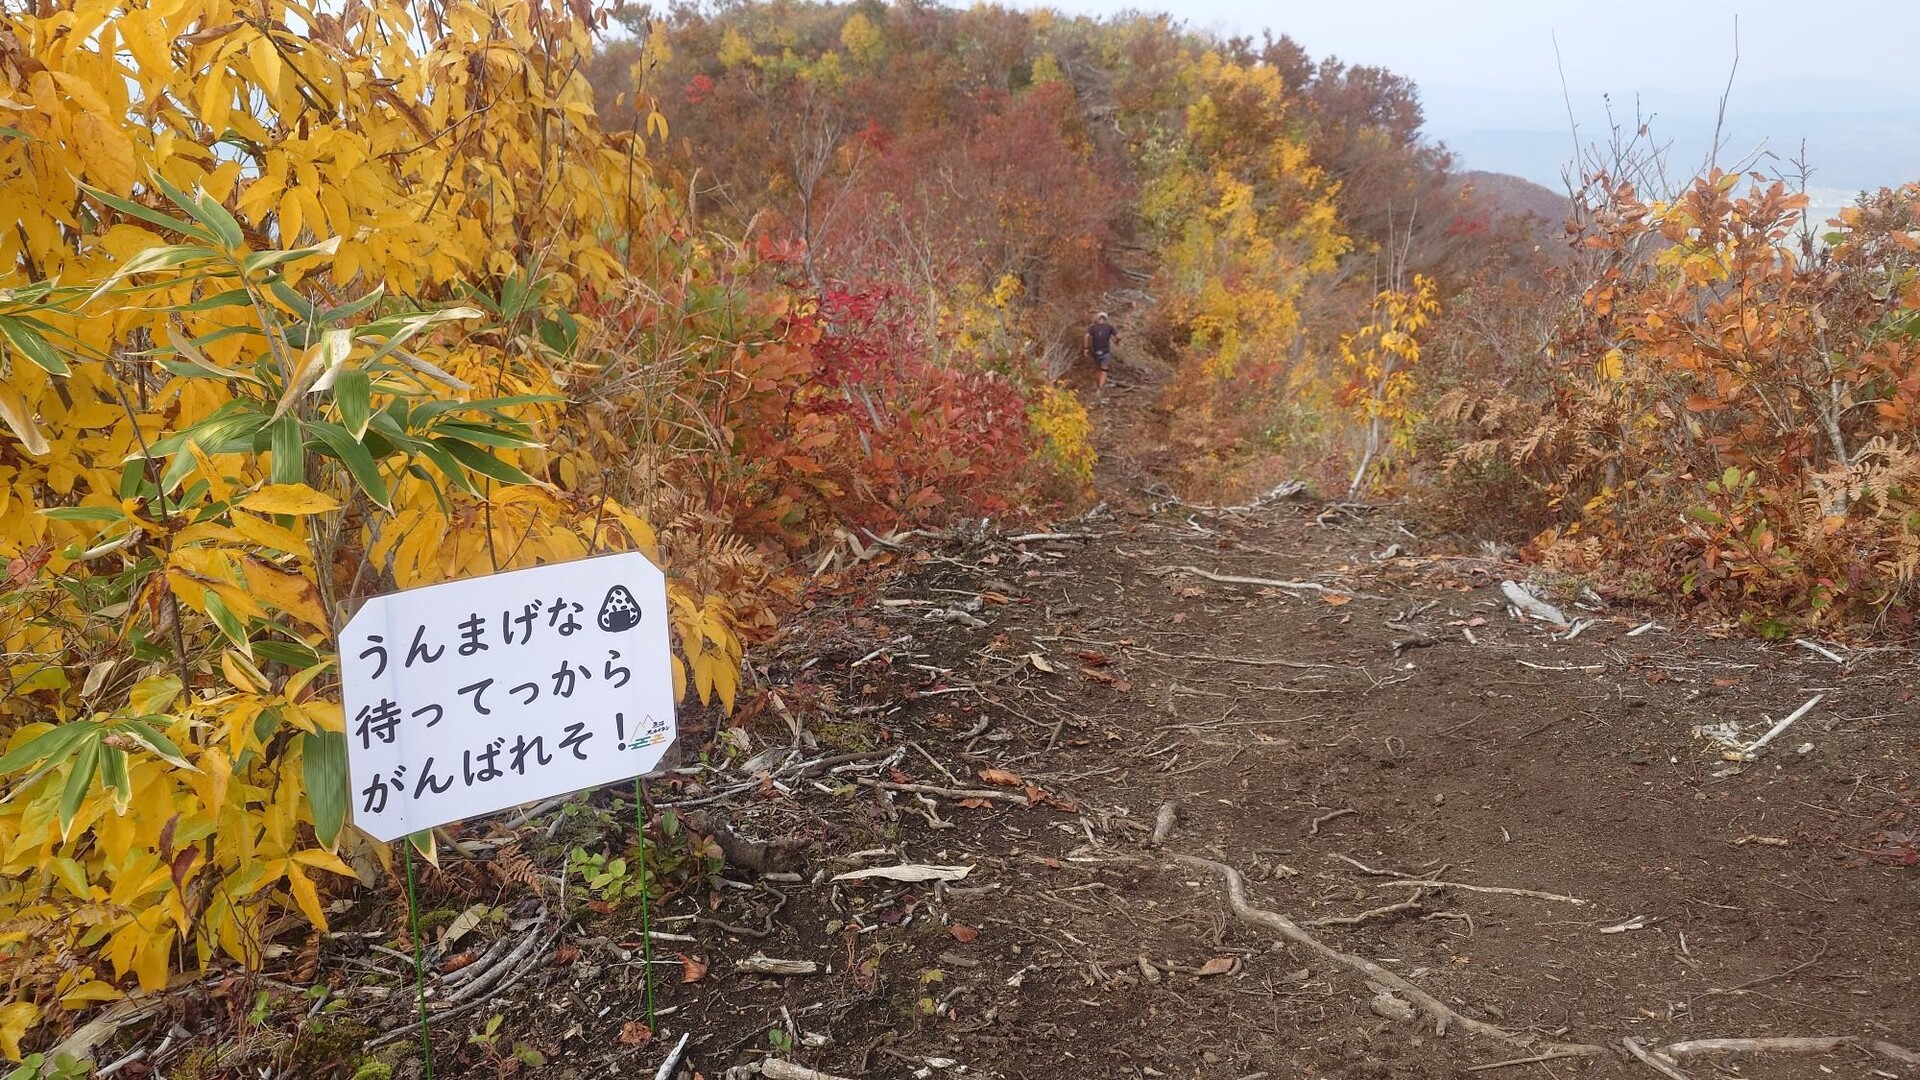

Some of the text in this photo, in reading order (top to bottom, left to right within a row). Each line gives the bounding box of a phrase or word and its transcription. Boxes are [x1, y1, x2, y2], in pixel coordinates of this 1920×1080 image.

[359, 597, 584, 680] うんまげな
[355, 650, 631, 750] 待ってっから
